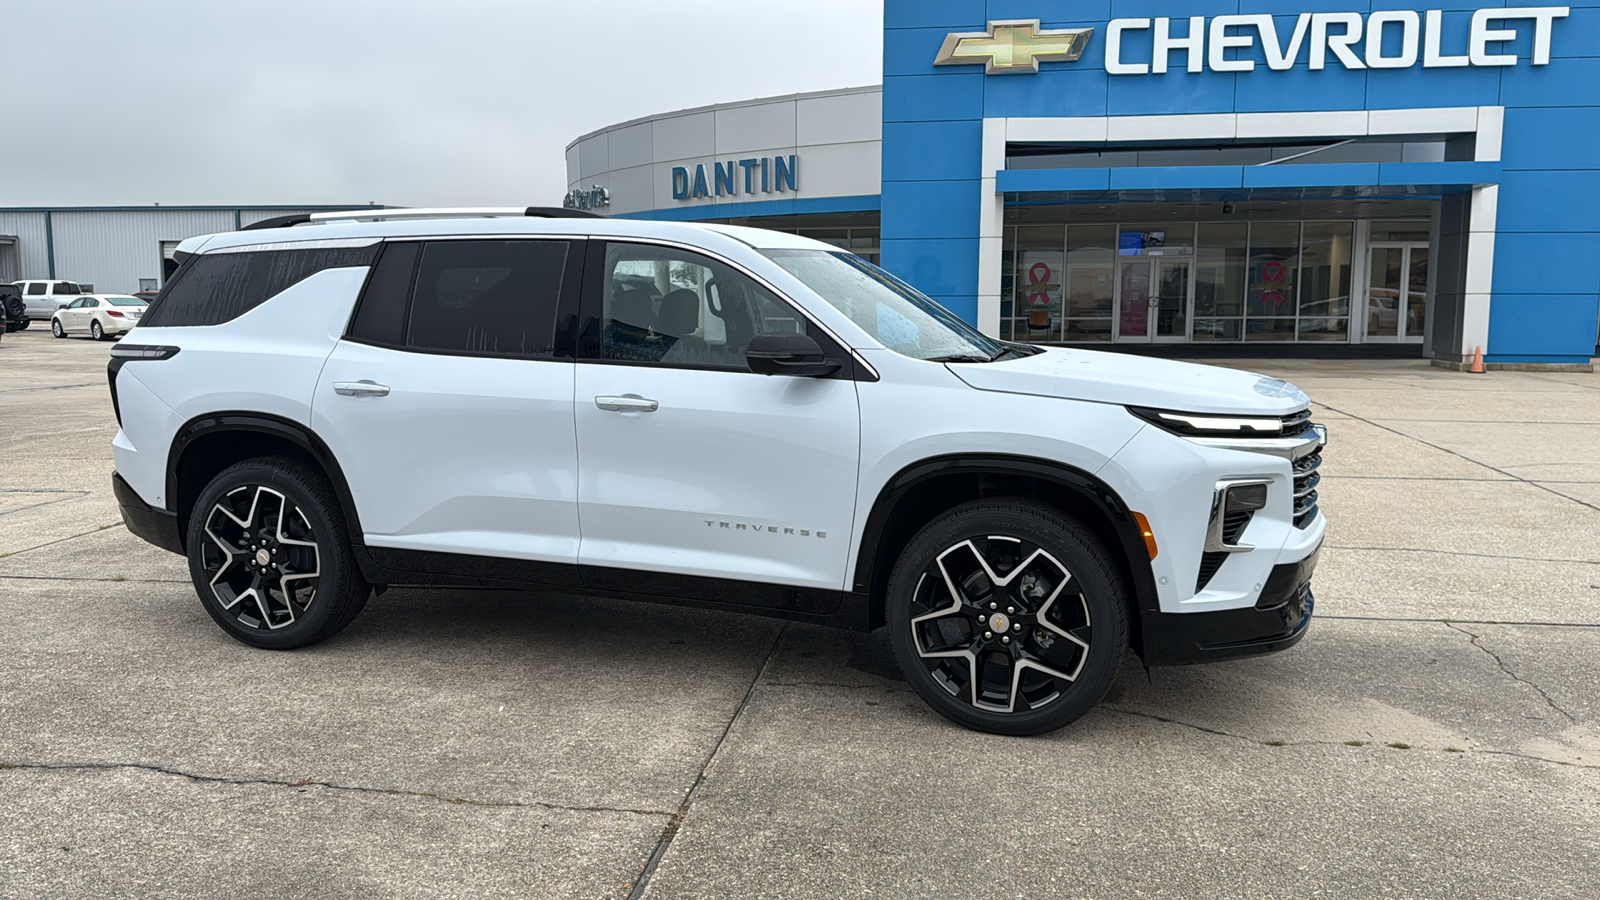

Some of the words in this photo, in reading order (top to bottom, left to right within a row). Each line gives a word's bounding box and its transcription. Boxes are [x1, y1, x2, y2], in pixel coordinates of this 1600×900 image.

[1104, 6, 1570, 75] CHEVROLET
[672, 155, 797, 200] DANTIN
[704, 520, 827, 539] TRAVERSE
